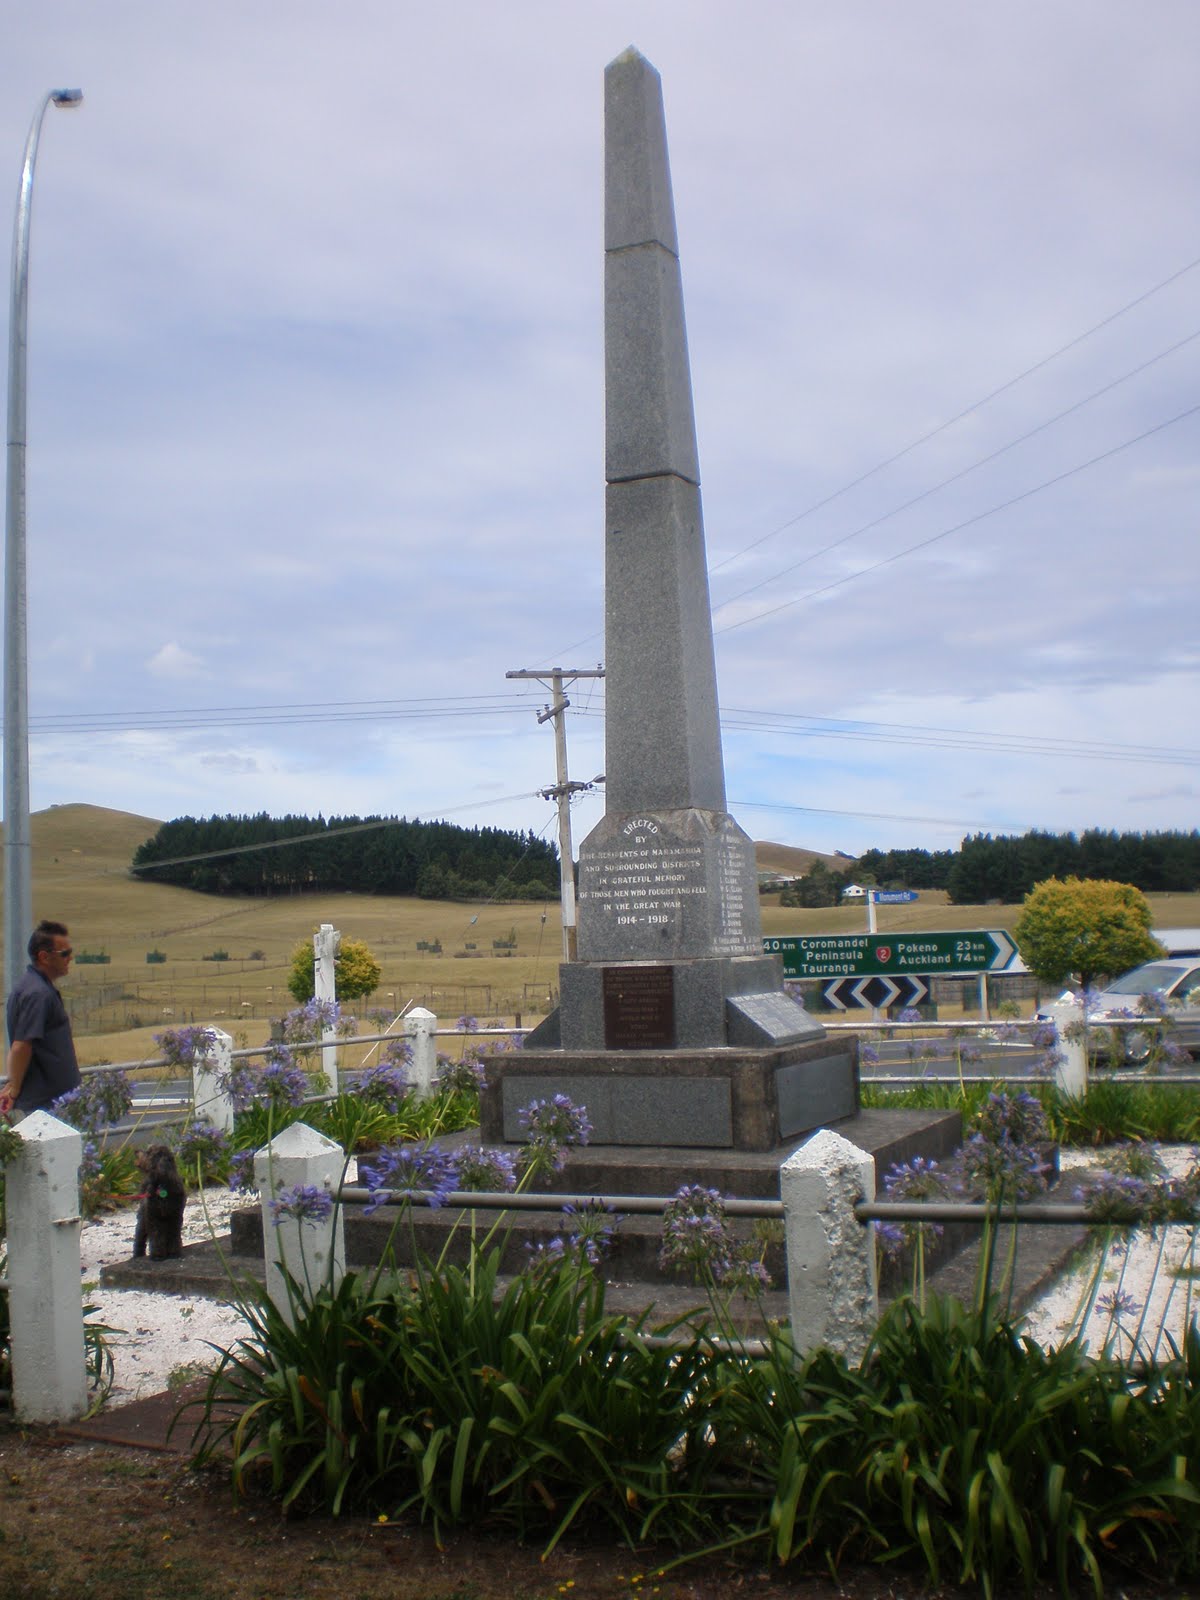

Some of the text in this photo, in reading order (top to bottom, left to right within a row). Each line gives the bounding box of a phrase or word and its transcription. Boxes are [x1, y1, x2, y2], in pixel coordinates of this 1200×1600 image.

[623, 819, 659, 835] ERECTED
[635, 836, 647, 844] BY
[584, 865, 600, 873] AND
[612, 876, 652, 884] GRATEFUL
[655, 874, 686, 882] MEMORY
[591, 890, 612, 899] THOSE
[630, 889, 647, 897] WHO
[648, 887, 674, 896] FOUGHT
[677, 887, 691, 895] AND
[634, 902, 659, 910] GREAT
[617, 916, 637, 925] 1914
[763, 940, 780, 950] 40
[782, 942, 796, 950] km
[801, 938, 868, 950] Coromandel
[898, 941, 985, 953] Pokeno 23 km
[806, 950, 864, 961] Peninsula
[880, 949, 887, 959] 2
[899, 953, 986, 965] Auckland 74 km
[783, 963, 856, 975] km Tauranga
